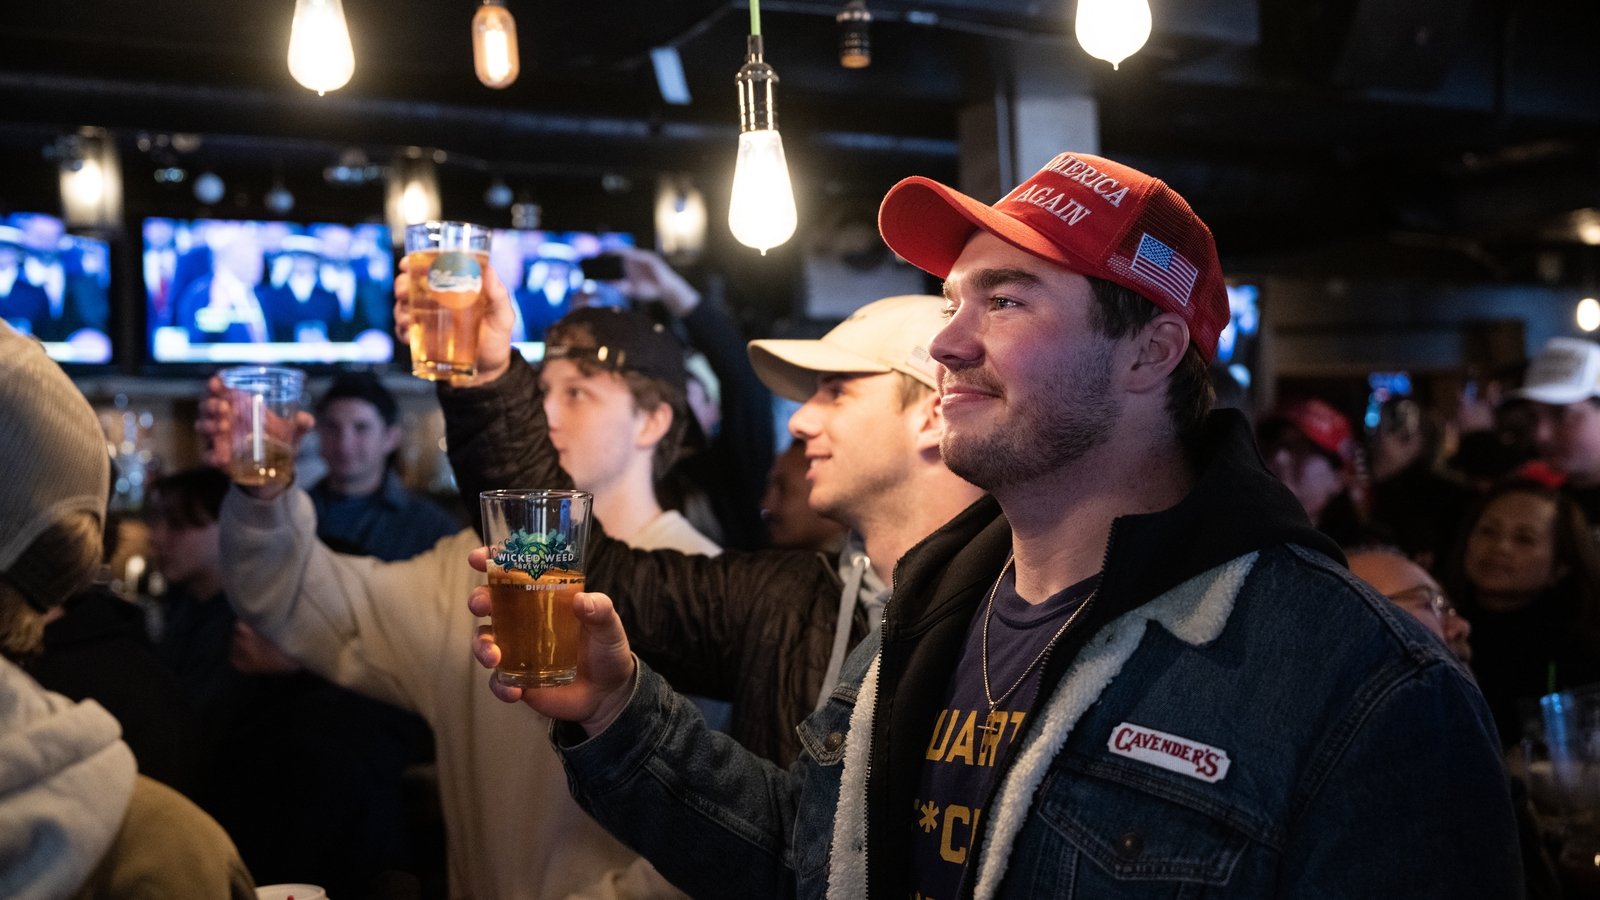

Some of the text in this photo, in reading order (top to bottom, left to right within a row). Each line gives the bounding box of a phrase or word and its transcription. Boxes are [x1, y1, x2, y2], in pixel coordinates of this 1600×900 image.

[1047, 154, 1130, 208] MERICA
[1014, 184, 1092, 227] AGAIN
[497, 553, 574, 563] WICKED WEED
[1114, 727, 1220, 778] CAVENDER'S
